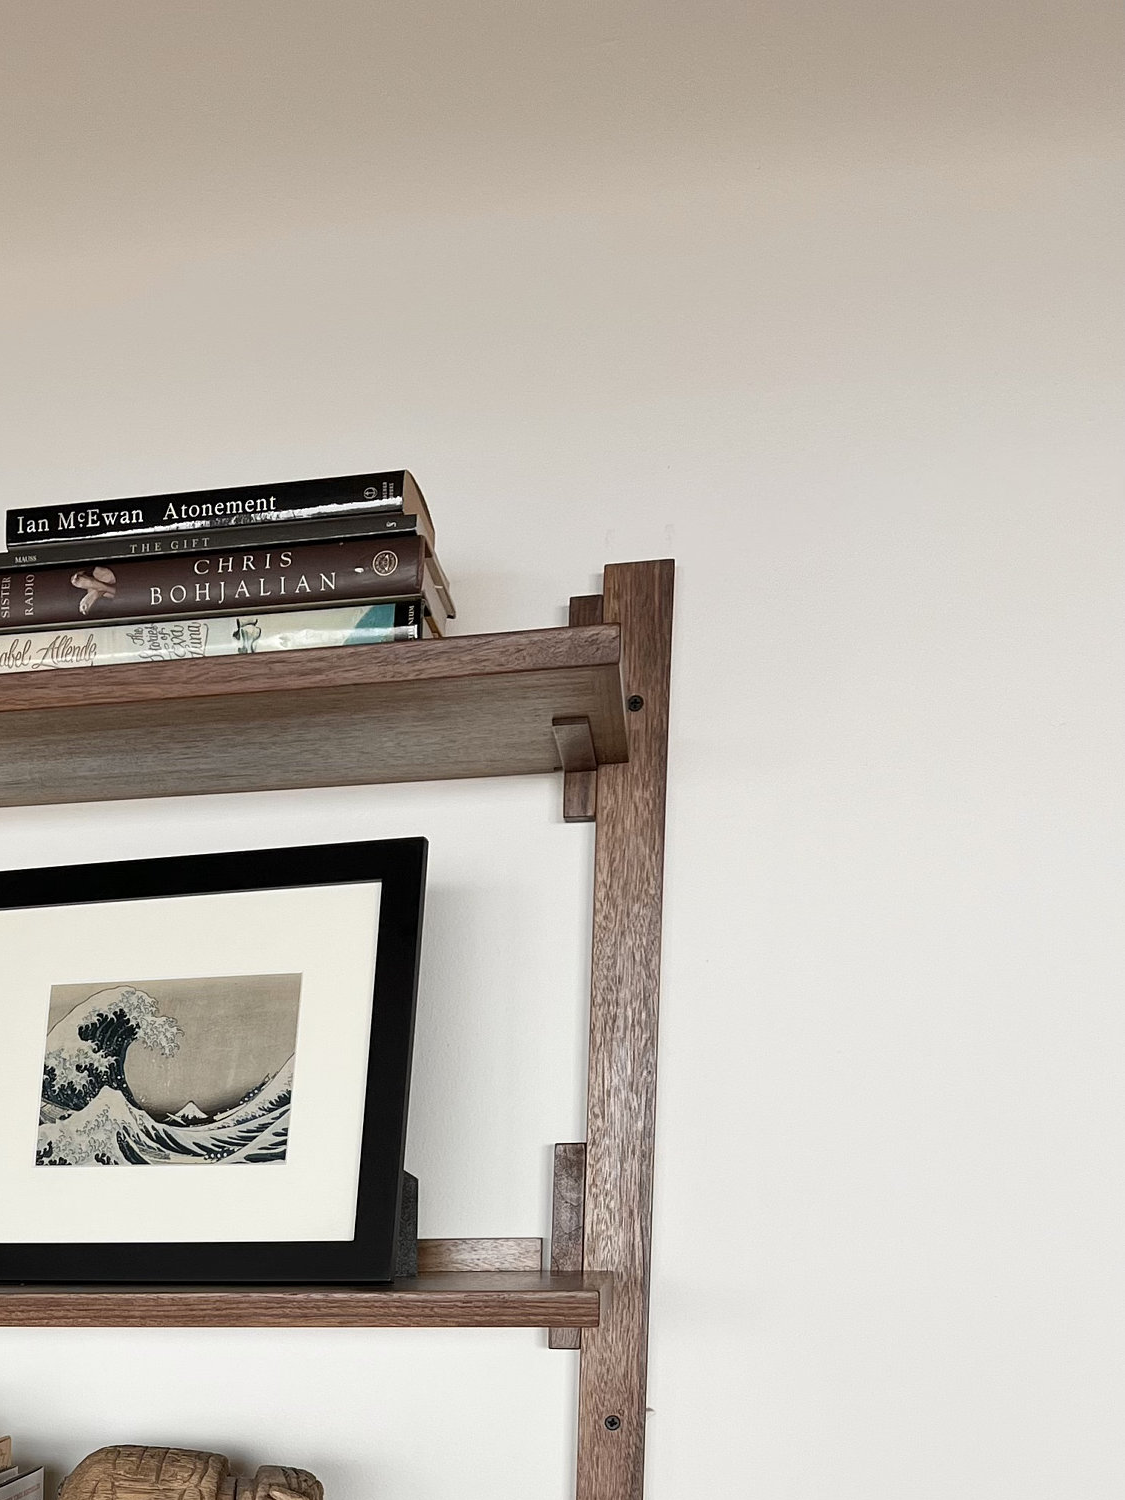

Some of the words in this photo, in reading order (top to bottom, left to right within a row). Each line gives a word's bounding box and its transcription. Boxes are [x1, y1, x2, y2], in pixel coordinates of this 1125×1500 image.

[17, 515, 49, 534] Ian
[58, 507, 144, 531] McEwan
[163, 495, 277, 521] Atonement
[15, 555, 37, 564] MAUSS
[129, 541, 162, 554] THE
[170, 537, 211, 551] GIFT
[193, 551, 294, 576] CHRIS
[1, 576, 11, 619] SISTER
[24, 574, 35, 616] RADIO
[149, 571, 338, 606] BOHJALIAN
[32, 633, 97, 669] Allende
